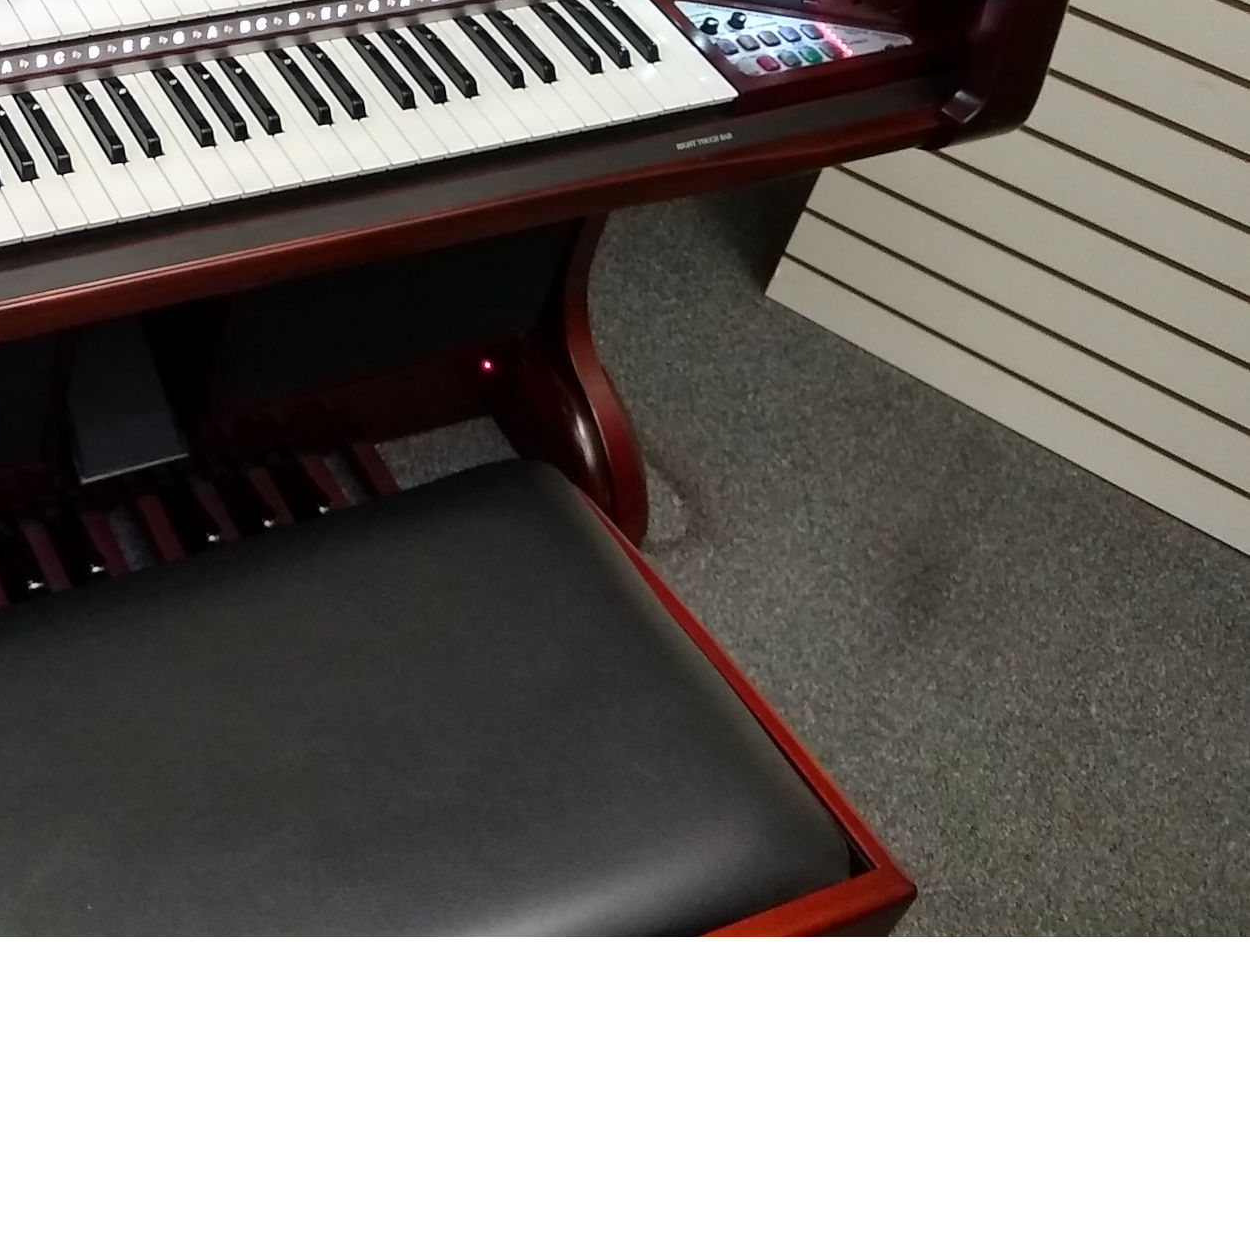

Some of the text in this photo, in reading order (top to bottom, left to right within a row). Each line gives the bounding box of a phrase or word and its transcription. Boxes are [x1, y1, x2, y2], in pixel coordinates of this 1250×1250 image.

[1, 60, 13, 74] A
[53, 51, 65, 65] C
[140, 36, 151, 51] F
[206, 25, 218, 40] A
[255, 17, 267, 31] C
[337, 4, 348, 18] F
[720, 132, 733, 142] BAR
